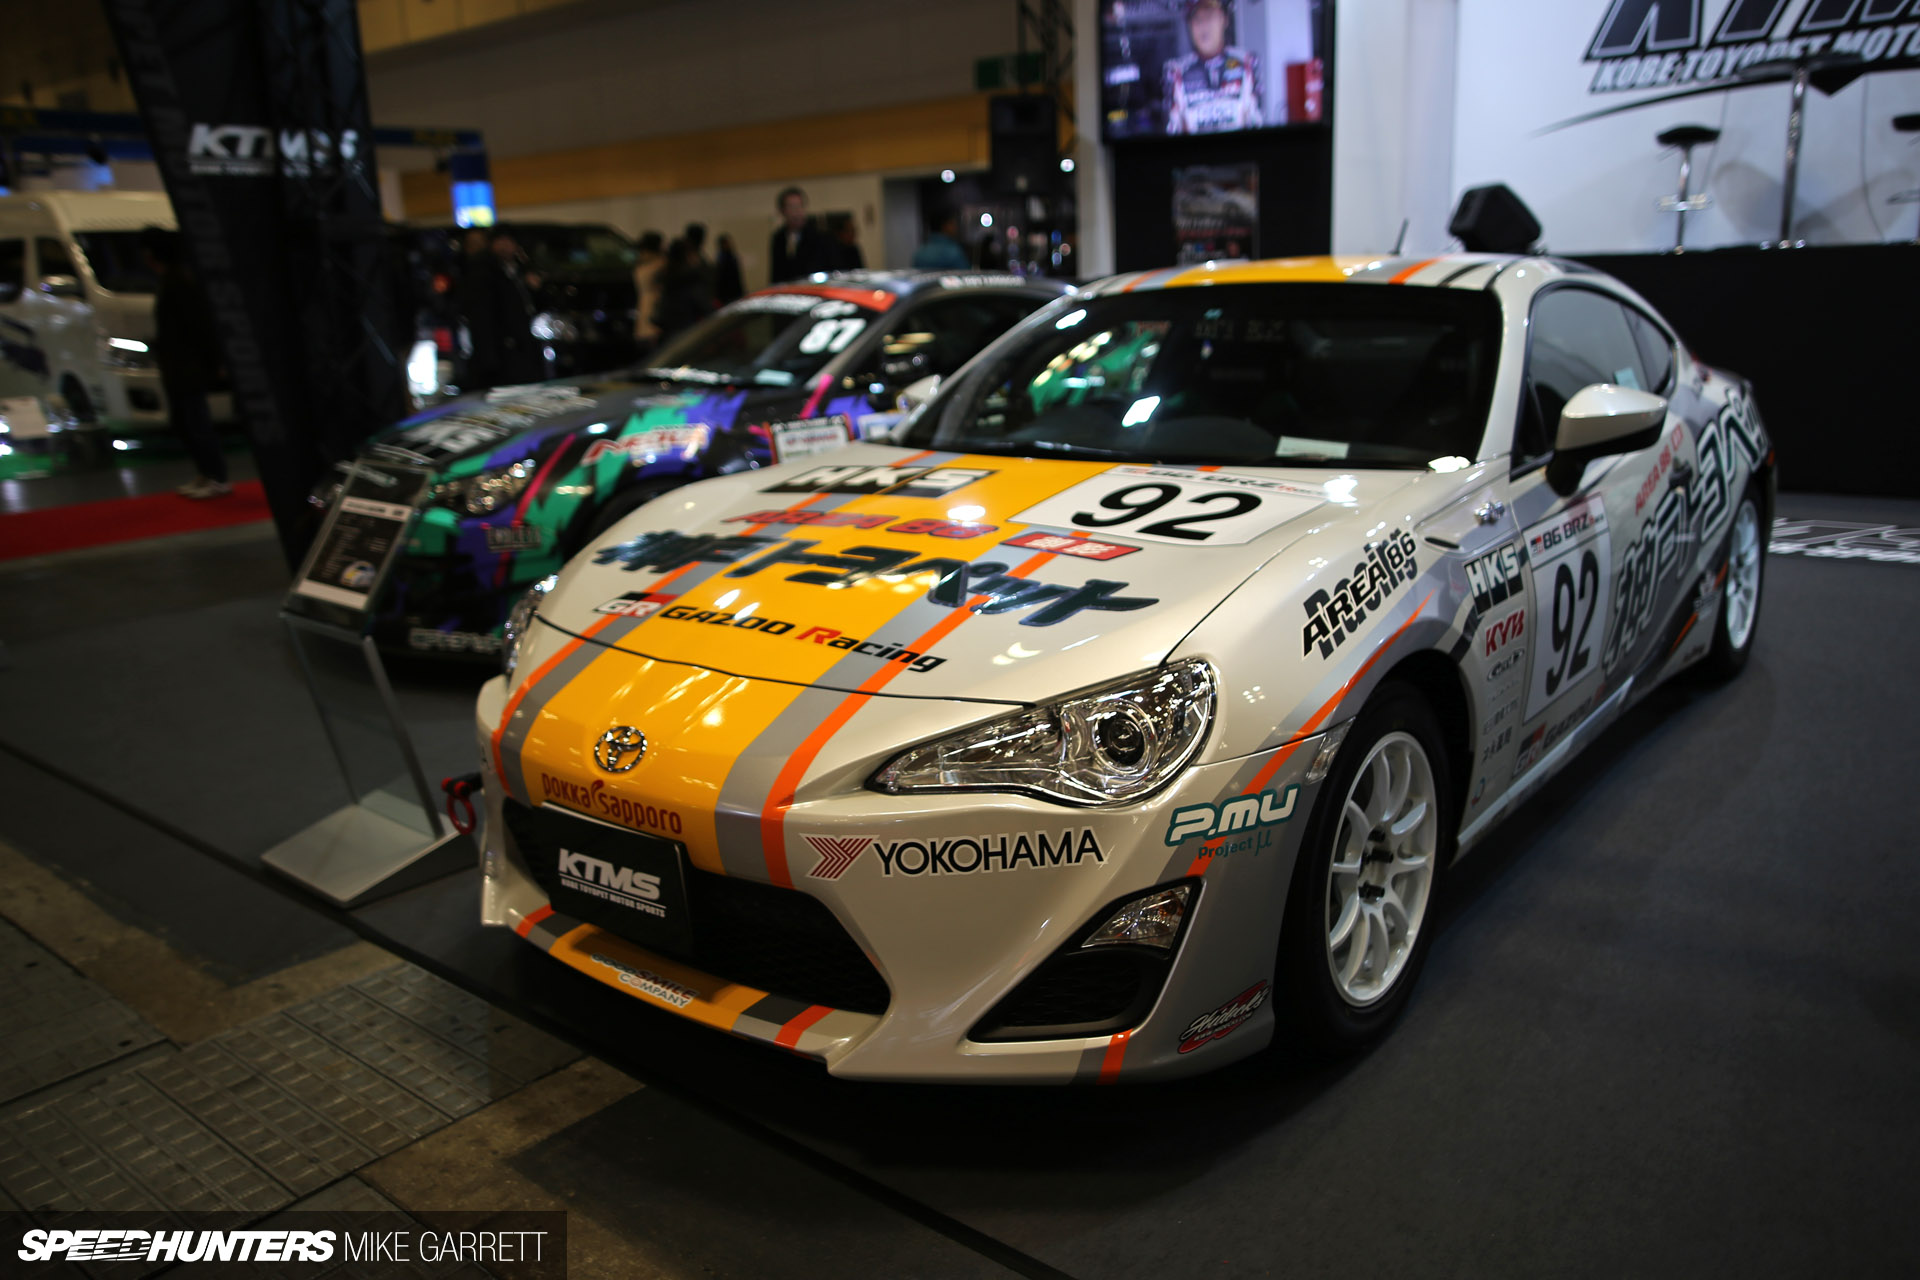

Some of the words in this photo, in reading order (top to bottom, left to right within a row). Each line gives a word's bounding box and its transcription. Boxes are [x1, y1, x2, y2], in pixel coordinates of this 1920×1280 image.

[787, 465, 990, 490] HKS
[885, 518, 999, 539] 86
[1071, 482, 1262, 541] 92
[1543, 530, 1562, 551] 86
[1564, 514, 1589, 540] BRZ
[1465, 547, 1521, 598] HKS
[1303, 559, 1389, 658] AREA
[1485, 608, 1525, 657] KYB
[1545, 549, 1600, 697] 92
[659, 605, 796, 635] GAZOO
[796, 626, 948, 673] Racing
[558, 847, 662, 901] KTMS
[872, 829, 1105, 876] YOKOHAMA
[618, 972, 689, 1008] COMPANY
